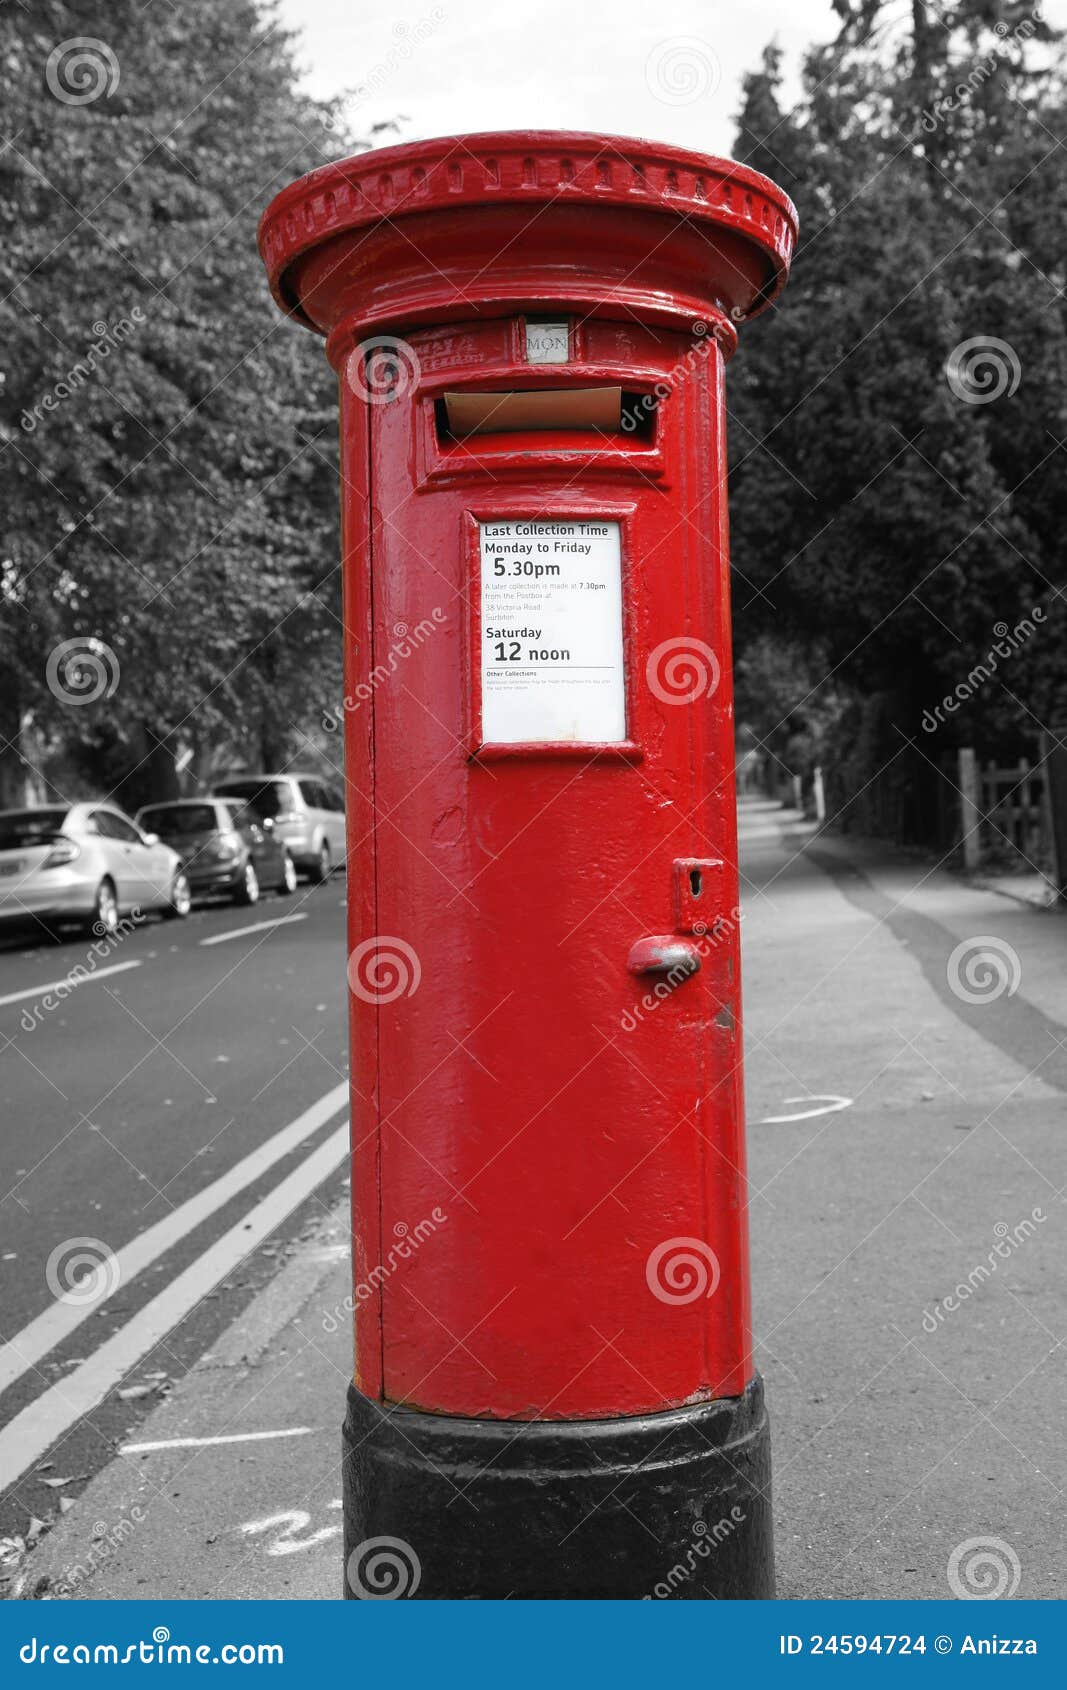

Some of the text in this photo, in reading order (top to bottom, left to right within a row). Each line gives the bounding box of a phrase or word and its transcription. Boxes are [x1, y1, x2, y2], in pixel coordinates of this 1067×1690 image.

[527, 335, 567, 351] MON
[485, 524, 609, 536] Last Collection Time
[485, 542, 592, 555] Monday to Friday
[494, 557, 560, 579] 5.30pm
[579, 582, 606, 591] 7.30pm
[485, 592, 501, 601] from
[503, 592, 515, 600] the
[486, 627, 542, 640] Saturday
[494, 641, 570, 661] 12 noon
